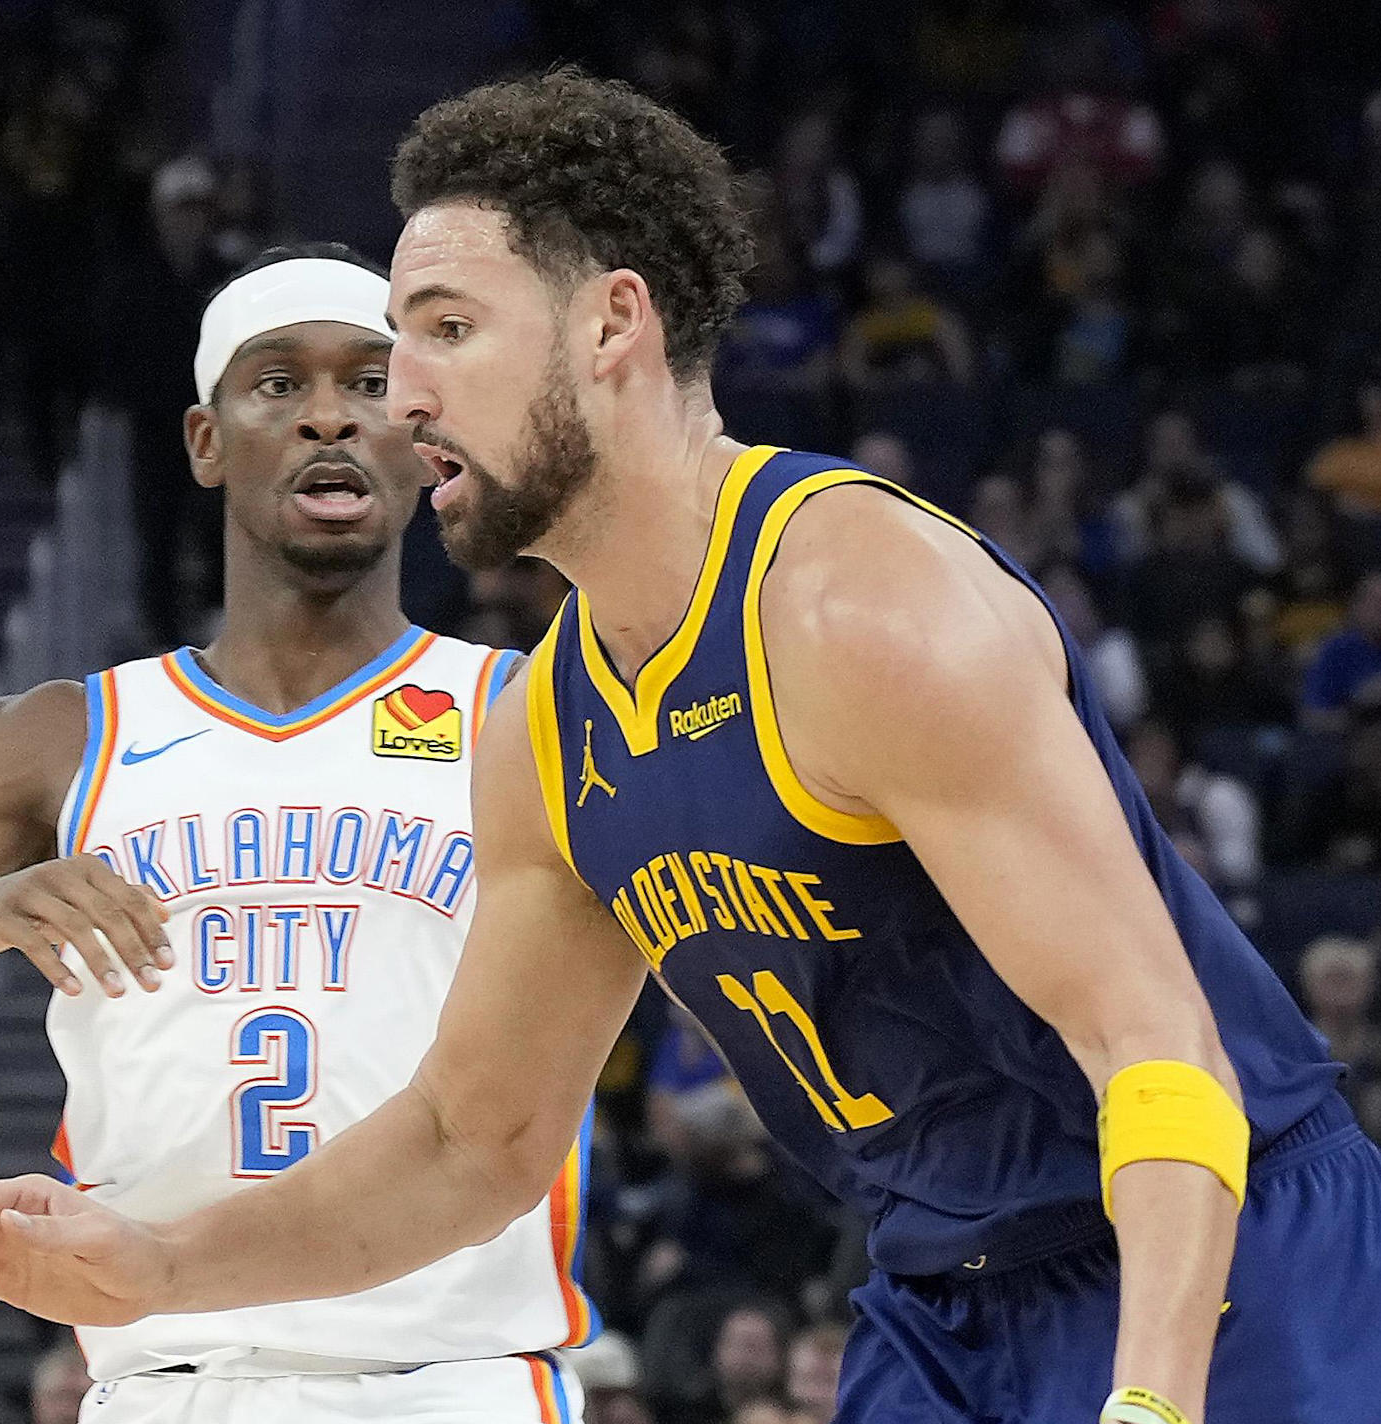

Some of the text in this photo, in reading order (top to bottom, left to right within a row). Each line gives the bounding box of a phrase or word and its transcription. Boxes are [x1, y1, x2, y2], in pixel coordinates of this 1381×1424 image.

[669, 692, 743, 738] Rakuten
[192, 904, 360, 993] CITY
[611, 851, 865, 973] OLDEN STATE
[230, 1005, 319, 1180] 2
[716, 970, 896, 1134] 11
